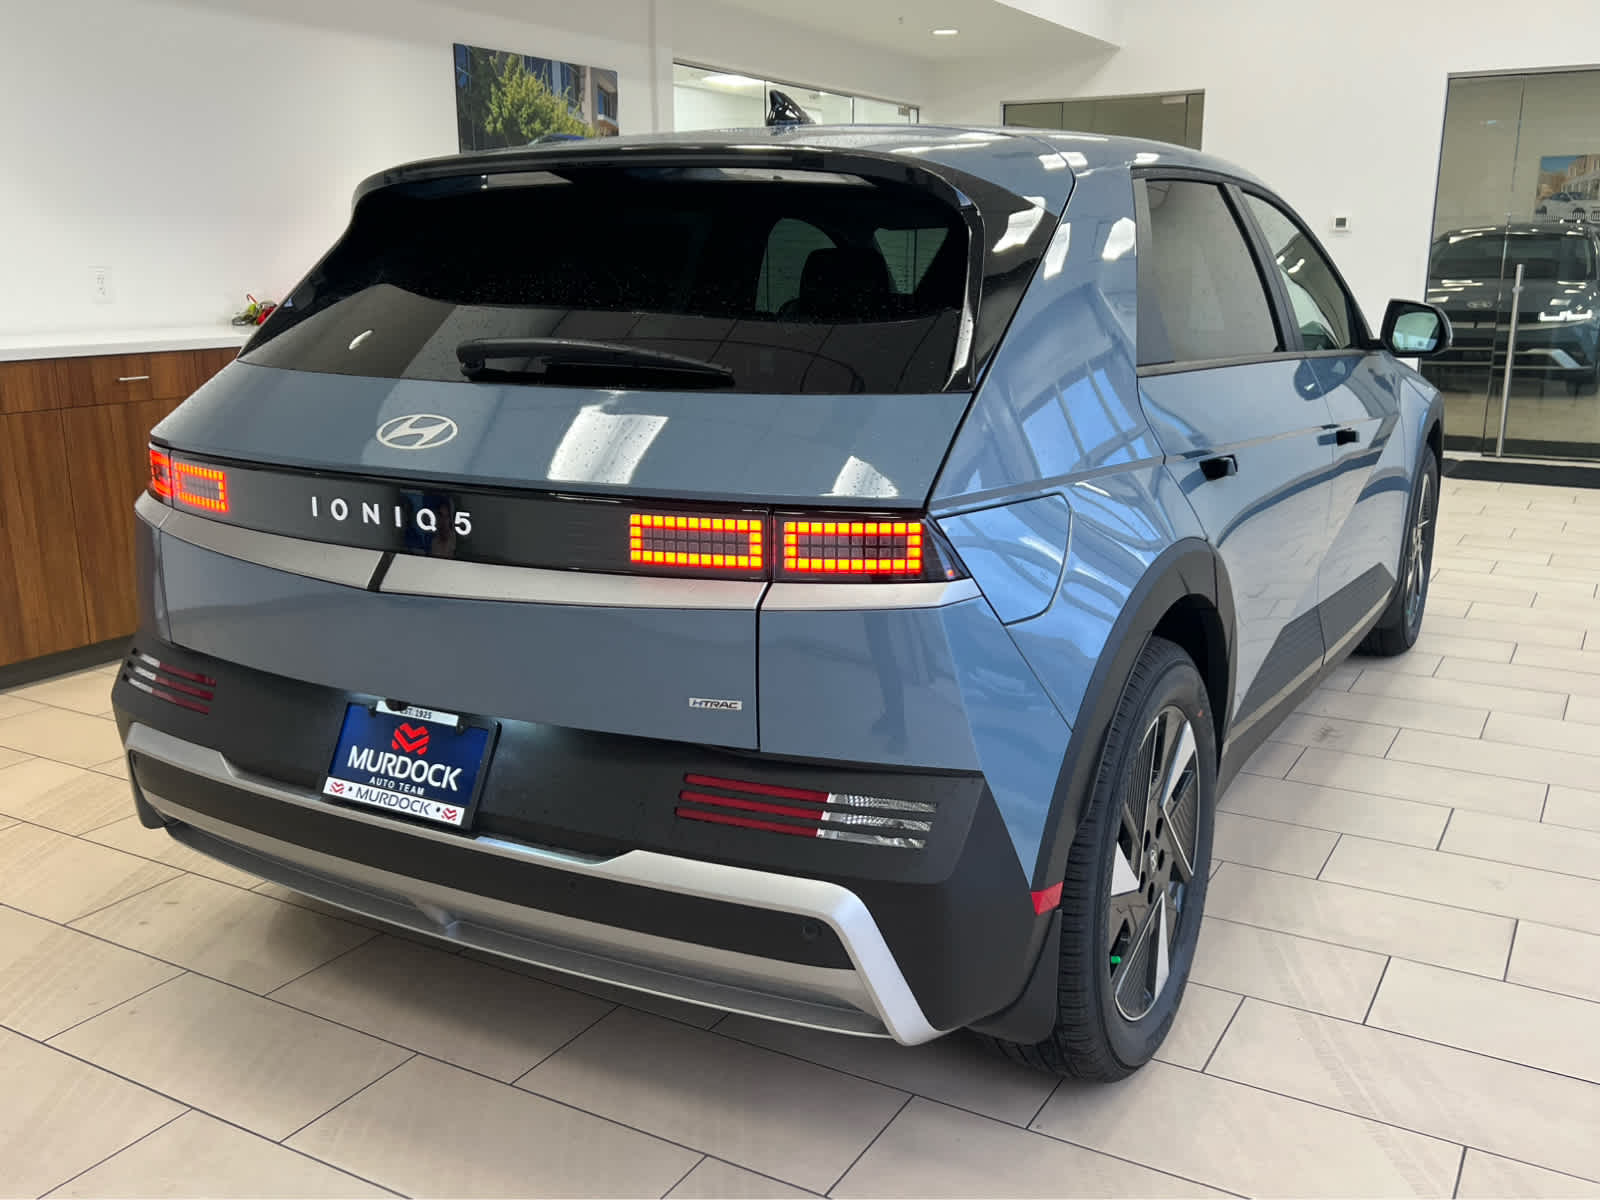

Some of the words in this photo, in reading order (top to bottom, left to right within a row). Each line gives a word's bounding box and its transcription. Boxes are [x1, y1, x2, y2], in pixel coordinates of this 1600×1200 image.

[311, 496, 437, 532] IONIQ
[454, 511, 472, 536] 5
[415, 709, 432, 720] 1925
[691, 699, 739, 709] HTRAC
[347, 745, 463, 791] MURDOCK
[369, 776, 396, 789] AUTO
[399, 782, 425, 796] TEAM
[355, 786, 432, 816] MURDOCK
